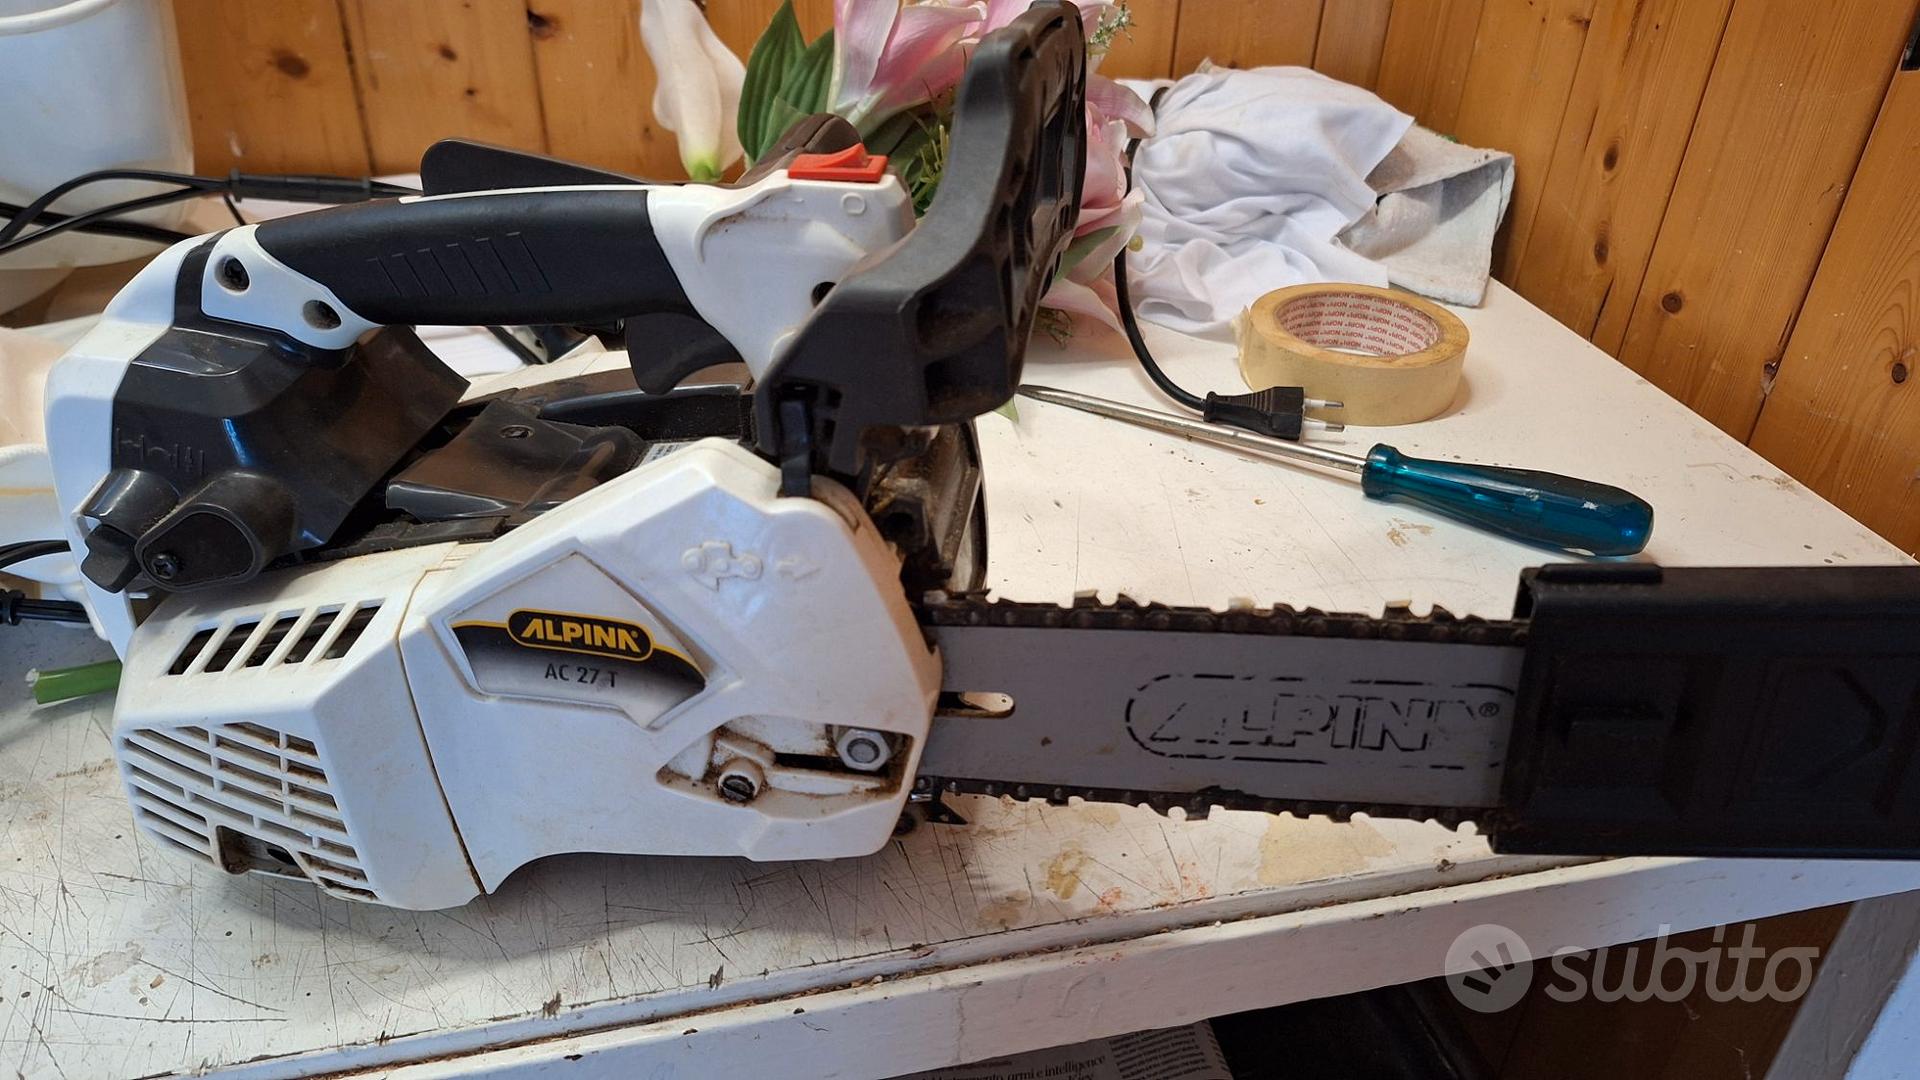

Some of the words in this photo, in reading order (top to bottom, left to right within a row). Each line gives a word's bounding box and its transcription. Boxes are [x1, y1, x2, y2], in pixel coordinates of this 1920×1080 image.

[520, 618, 641, 653] ALPINA
[544, 663, 570, 681] AC
[577, 667, 600, 684] 27
[608, 671, 619, 688] T
